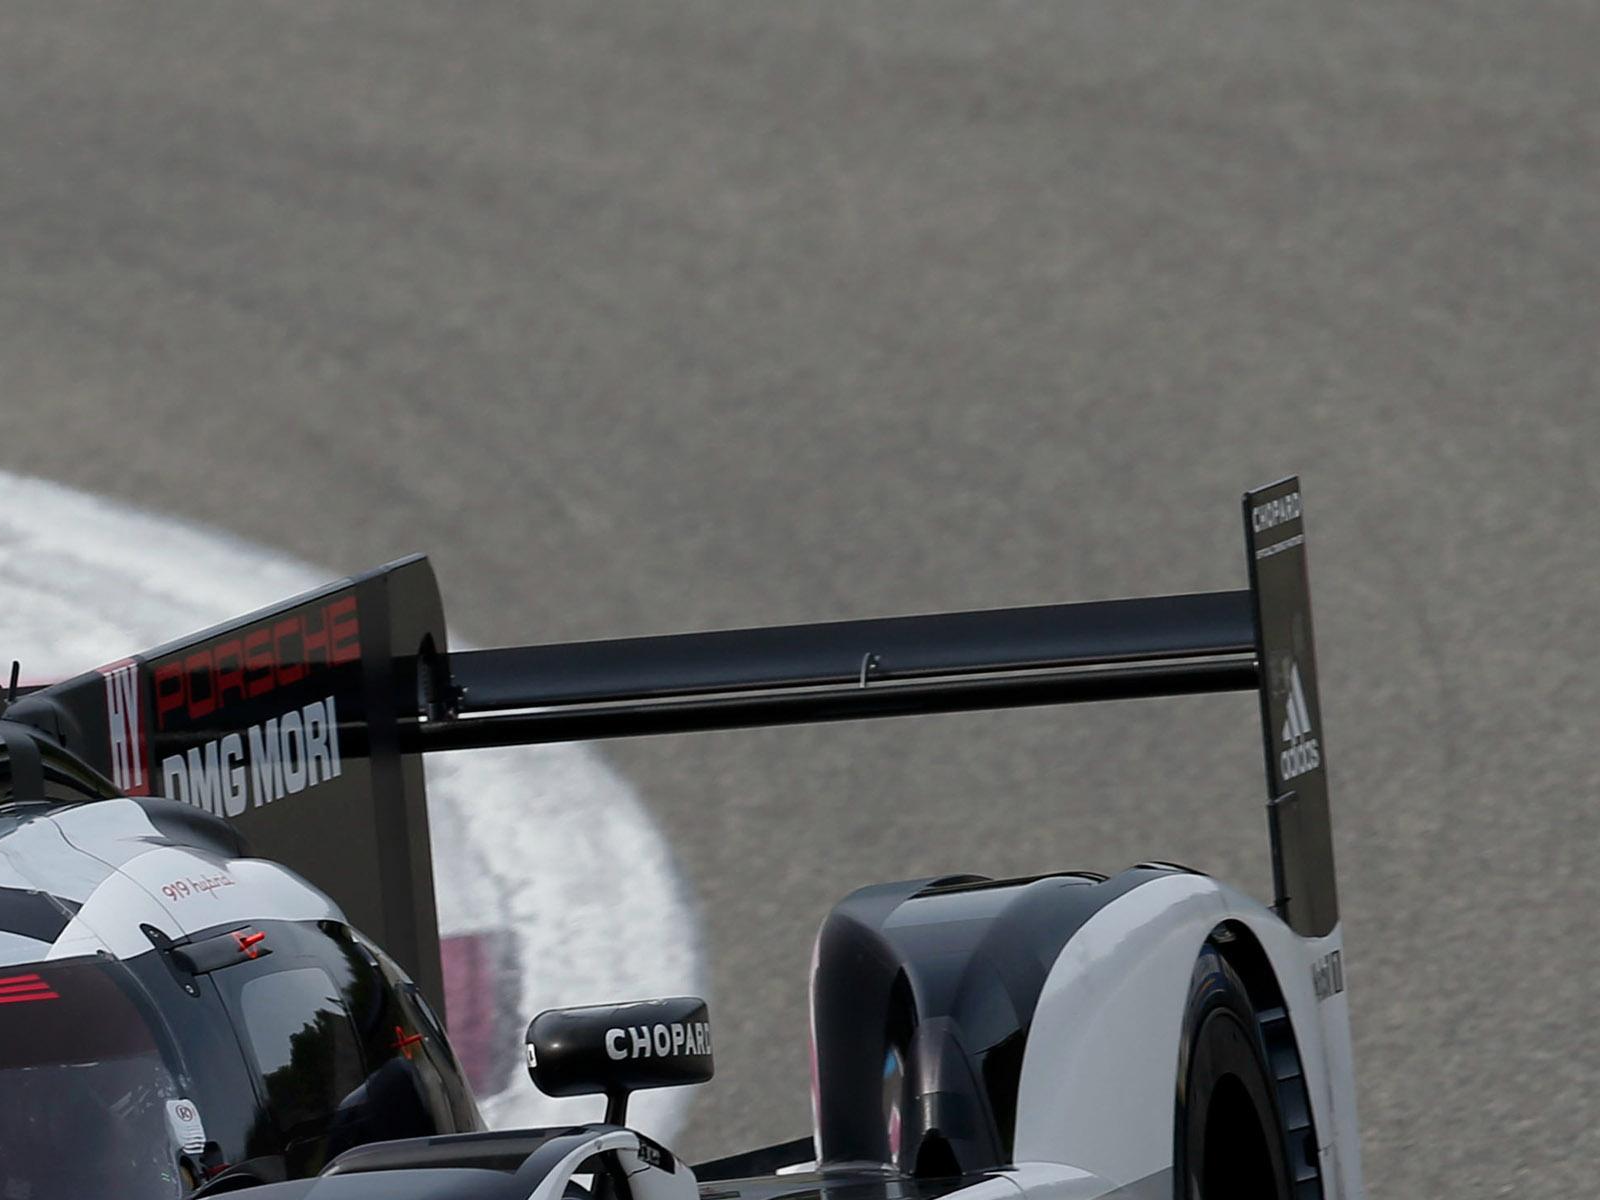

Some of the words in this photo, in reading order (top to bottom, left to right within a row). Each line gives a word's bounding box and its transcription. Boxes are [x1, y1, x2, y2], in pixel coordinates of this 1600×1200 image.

[154, 596, 362, 732] PORSCHE
[103, 663, 142, 792] HY
[162, 732, 247, 819] DMG
[248, 695, 342, 808] MORI
[161, 880, 190, 902] 919
[186, 873, 236, 901] hybrid
